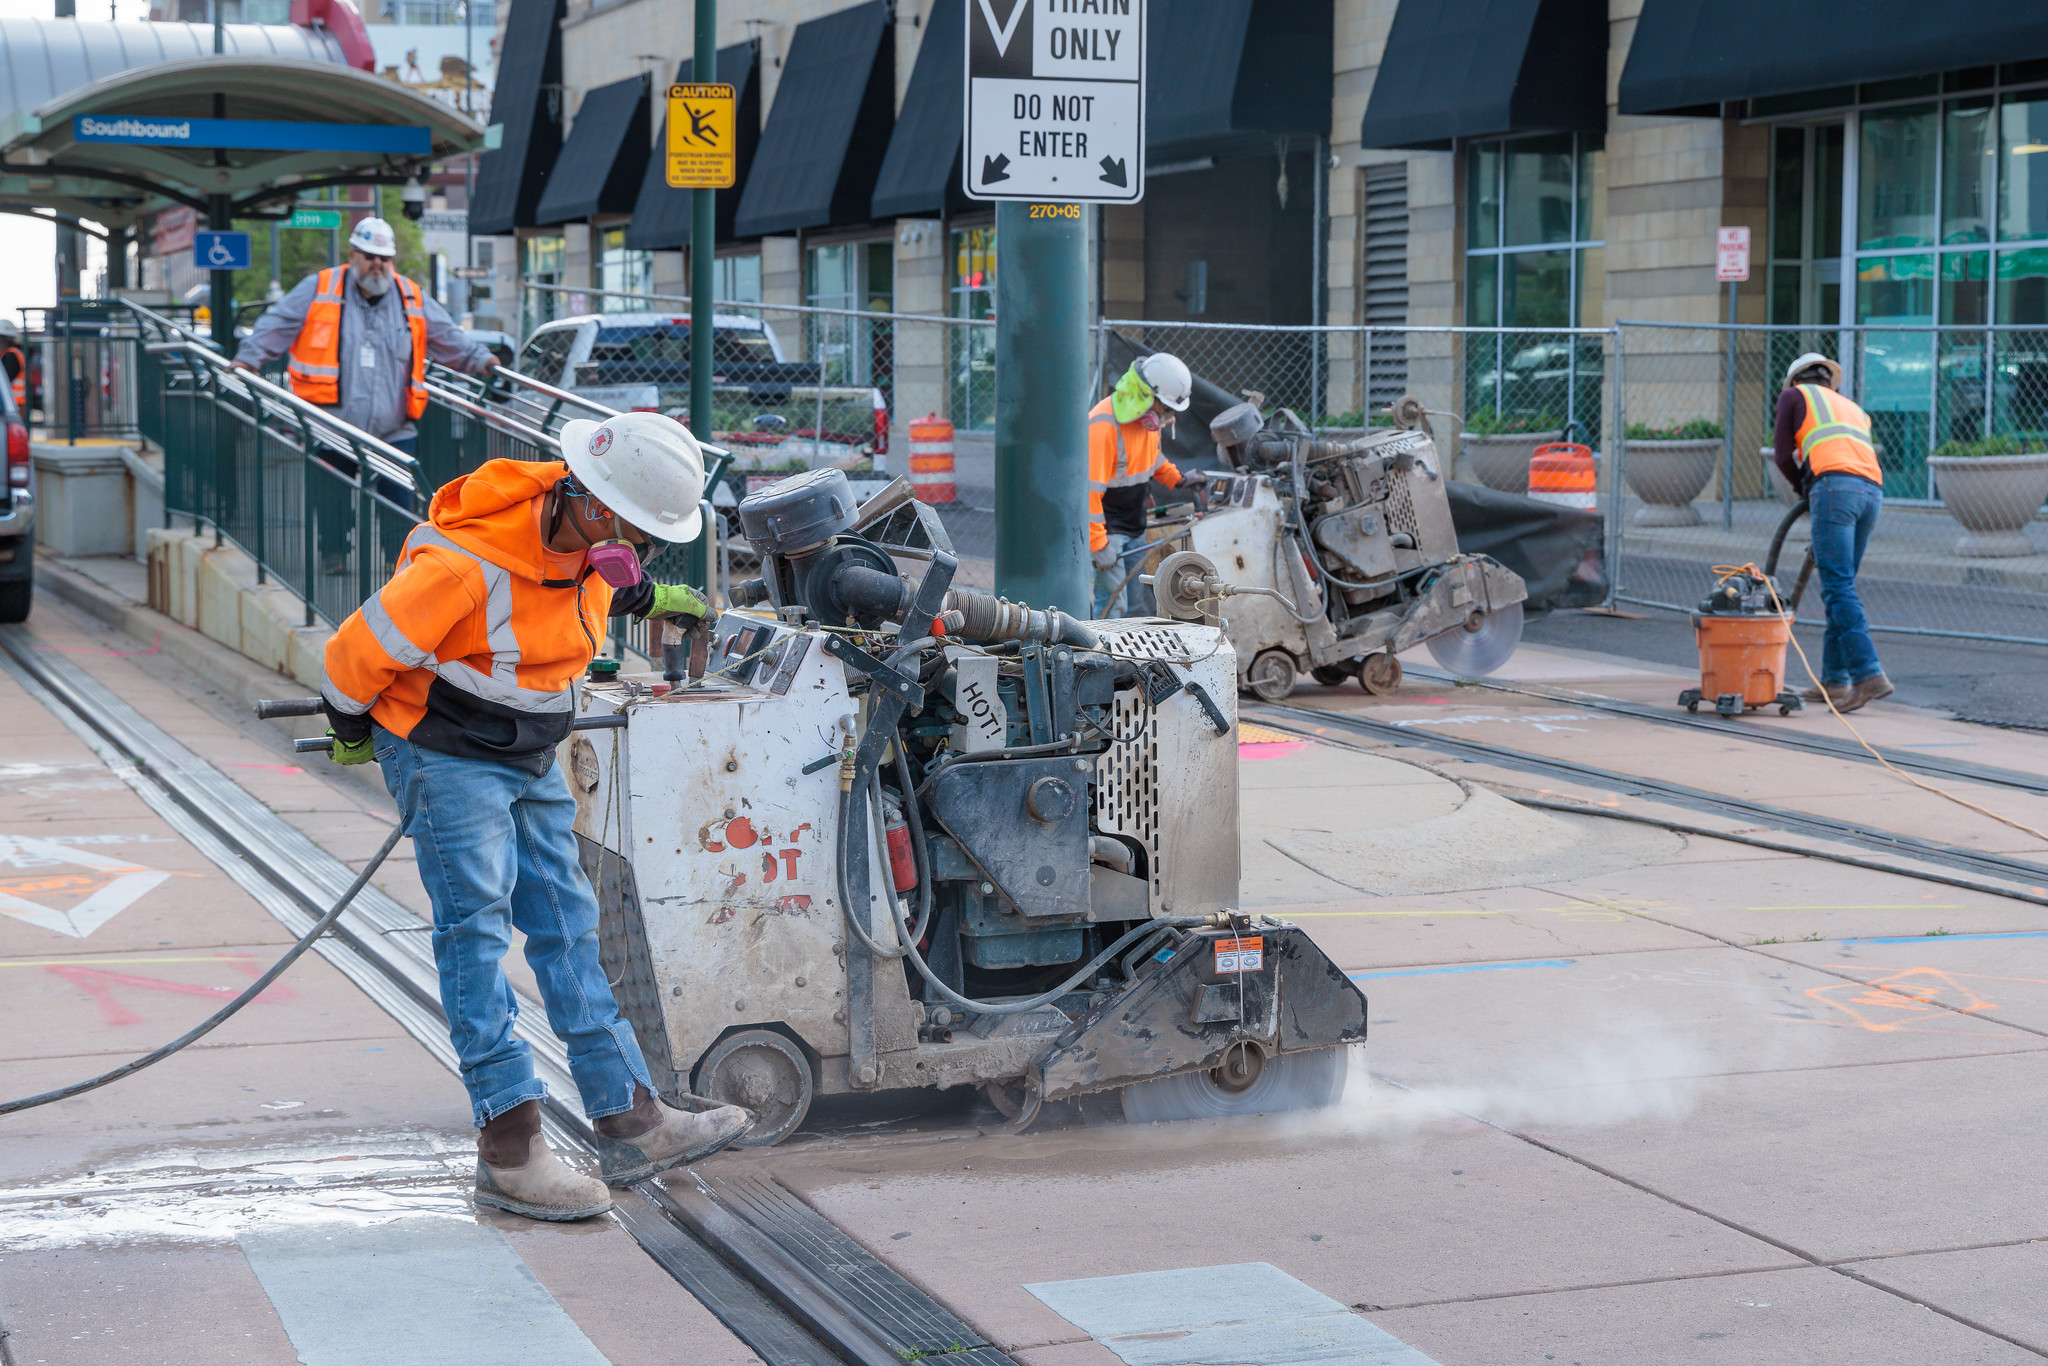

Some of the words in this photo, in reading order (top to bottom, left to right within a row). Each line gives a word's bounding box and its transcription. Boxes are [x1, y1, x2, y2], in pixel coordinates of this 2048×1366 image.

[1050, 27, 1121, 61] ONLY
[671, 86, 731, 98] CAUTION
[1013, 93, 1041, 120] DO
[1052, 95, 1095, 122] NOT
[80, 117, 190, 139] Southbound
[1019, 130, 1088, 158] ENTER
[1029, 204, 1081, 219] 270+05
[962, 682, 1002, 740] HOT!
